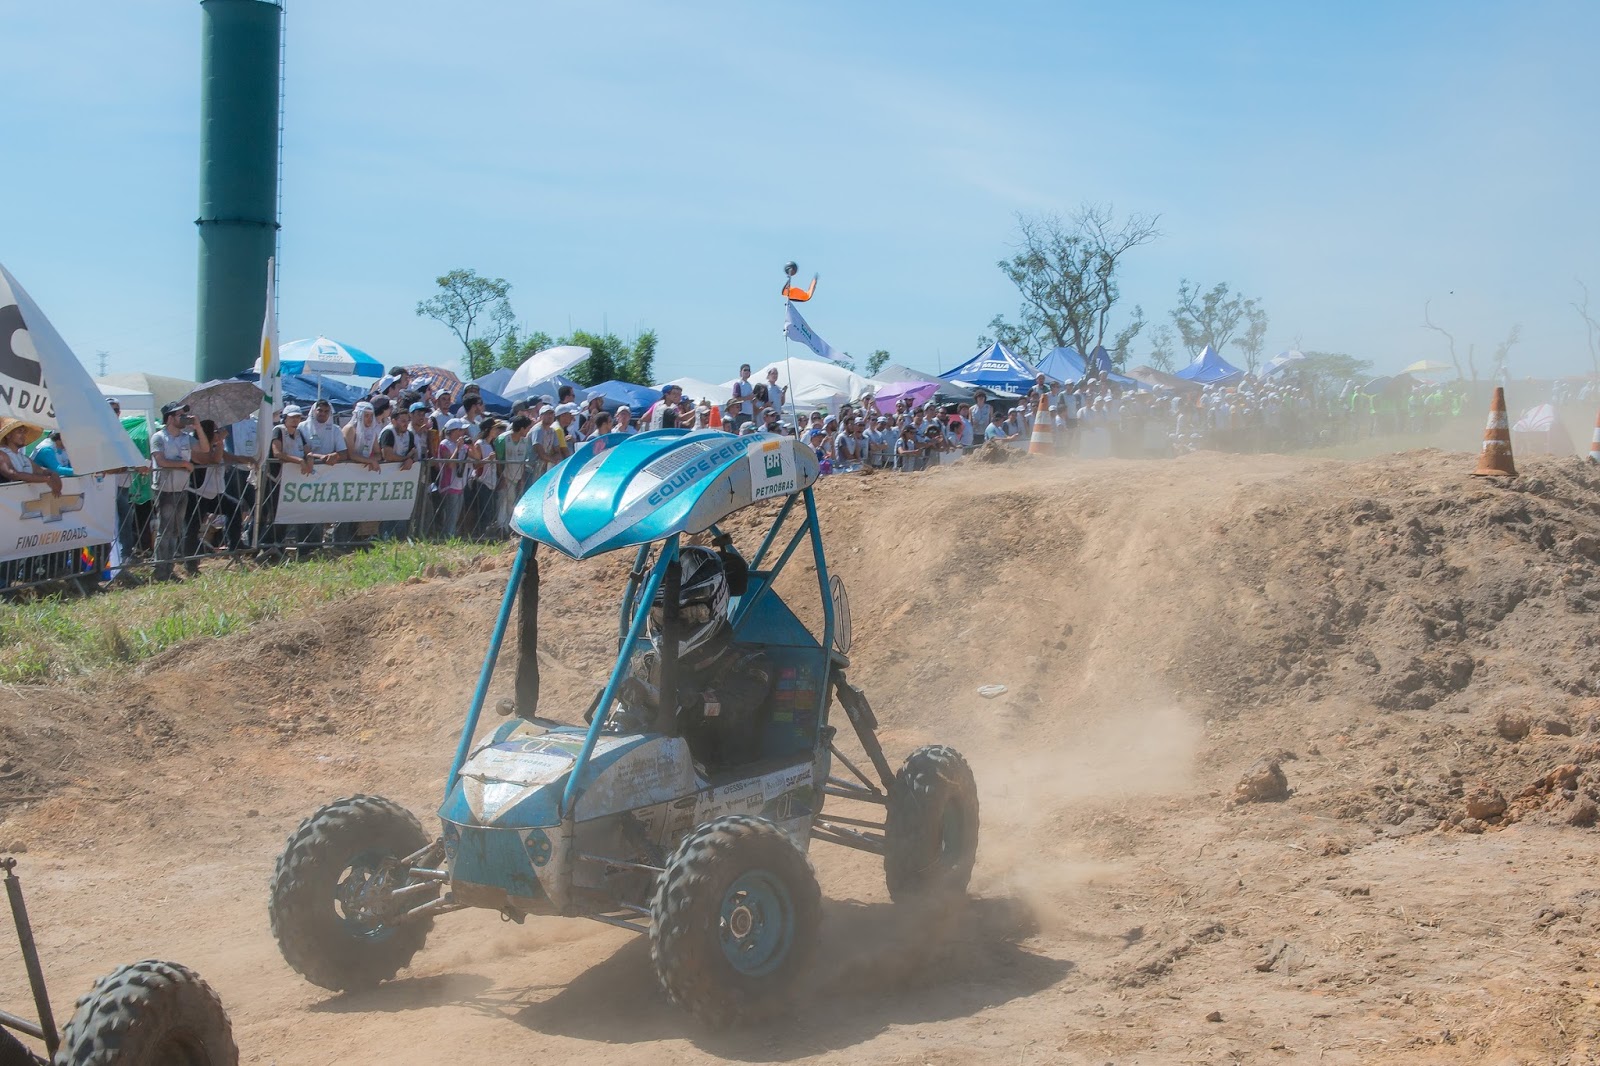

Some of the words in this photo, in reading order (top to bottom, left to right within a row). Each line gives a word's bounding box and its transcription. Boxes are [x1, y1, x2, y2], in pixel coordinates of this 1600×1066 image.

[766, 453, 781, 469] BR
[648, 463, 711, 506] EQUIPE
[709, 445, 735, 465] FEI
[282, 481, 415, 503] SCHAEFFLER
[755, 480, 795, 498] PETROBRAS
[15, 534, 39, 550] FIND
[37, 531, 61, 546] NEW
[60, 526, 88, 543] ROADS
